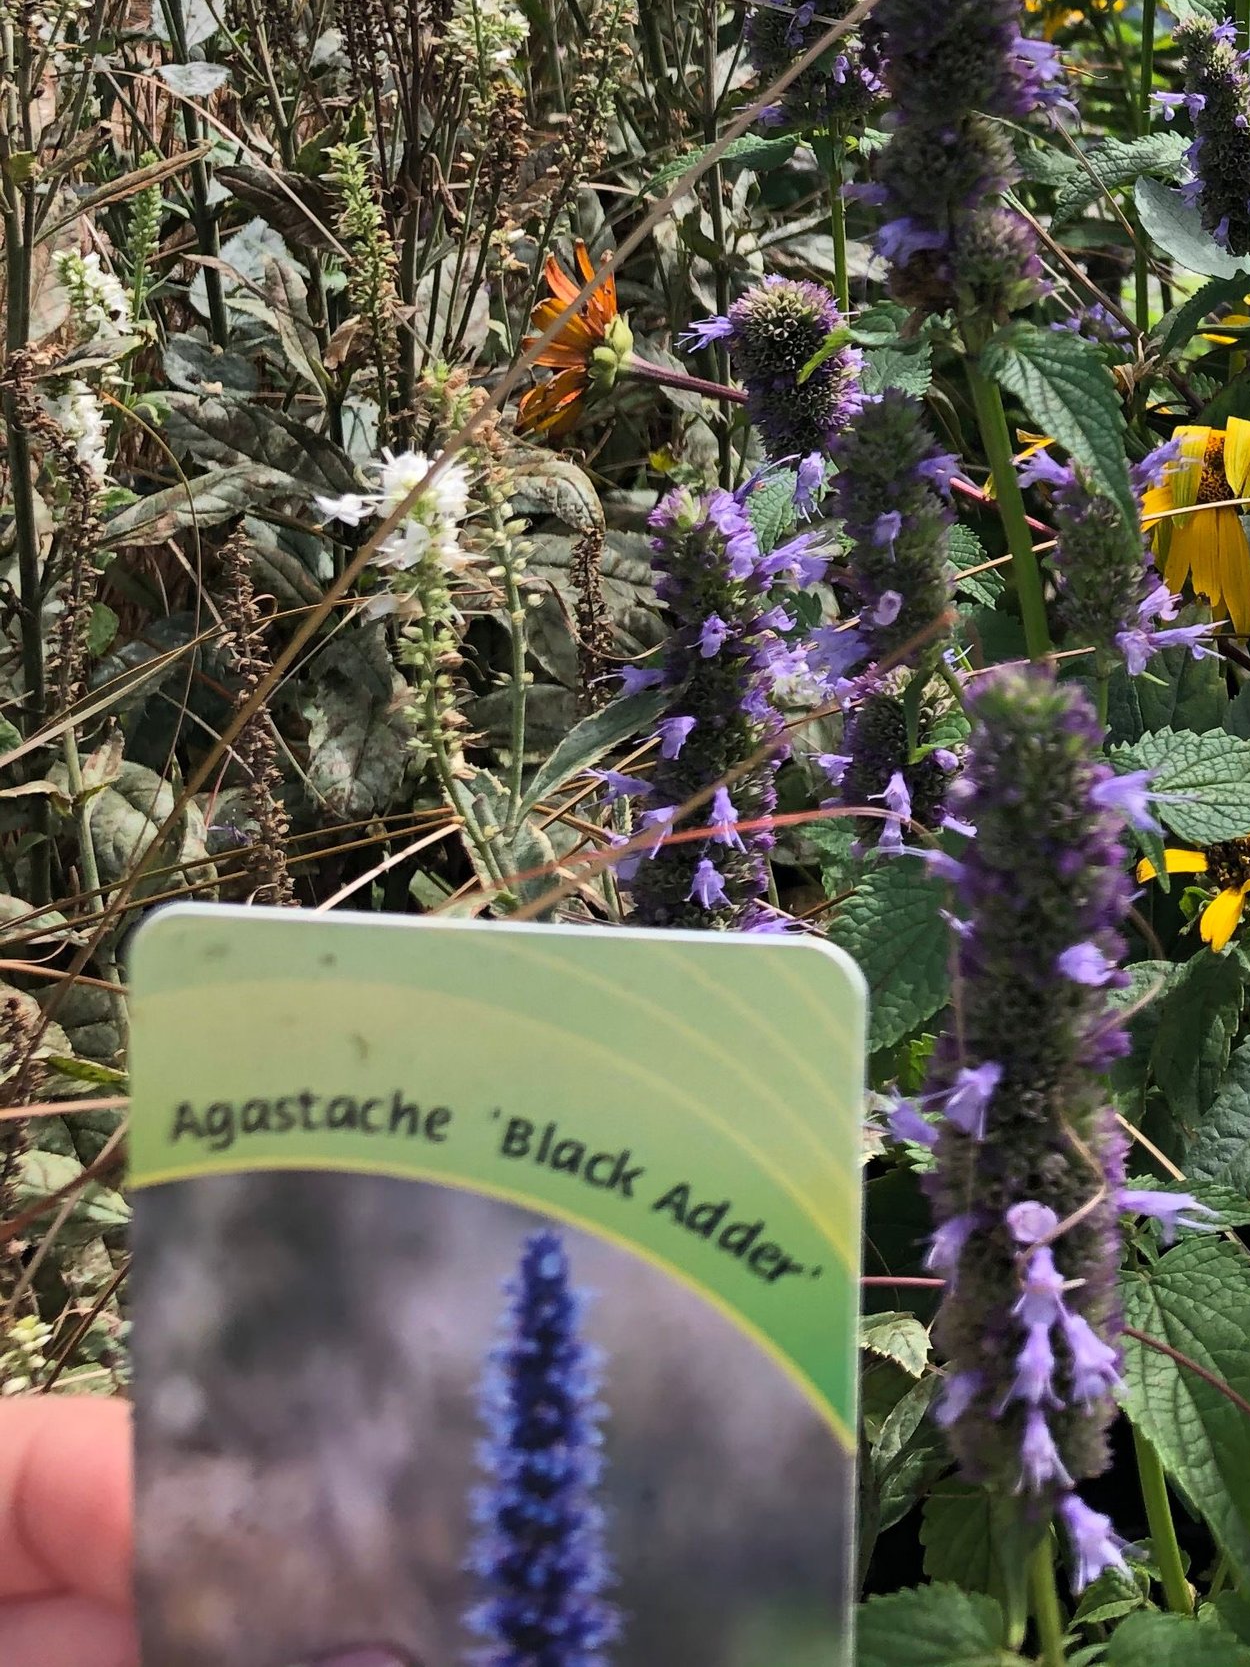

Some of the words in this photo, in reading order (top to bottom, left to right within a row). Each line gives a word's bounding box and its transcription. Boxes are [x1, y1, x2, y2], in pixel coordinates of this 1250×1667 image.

[169, 1089, 452, 1151] Agastache
[491, 1108, 644, 1198] 'Black
[651, 1181, 822, 1283] Adder'
